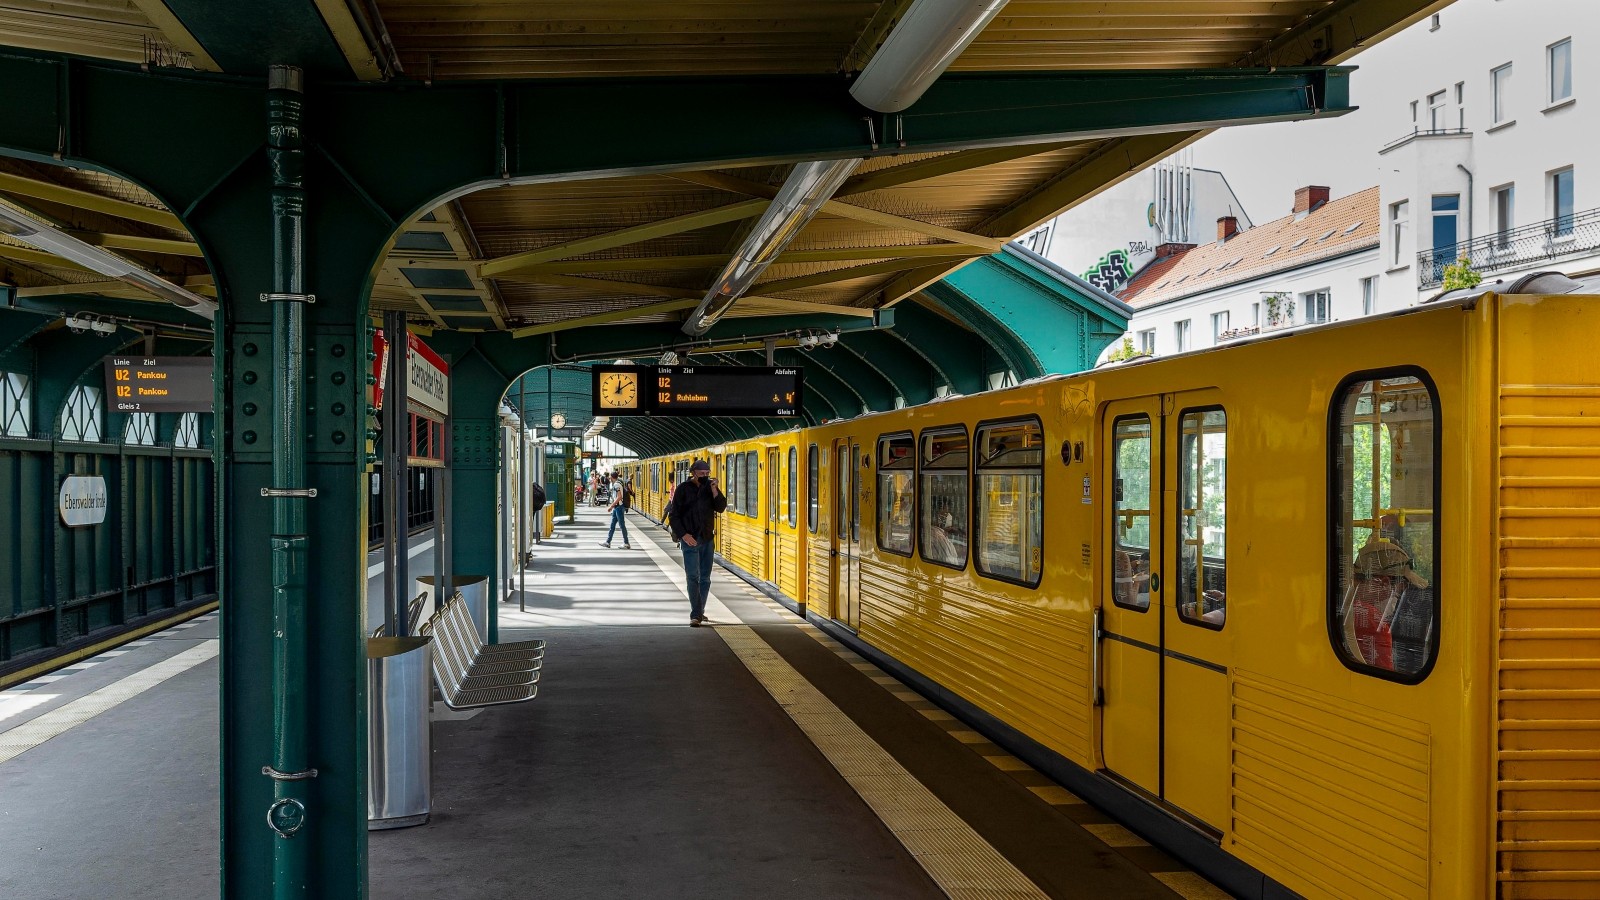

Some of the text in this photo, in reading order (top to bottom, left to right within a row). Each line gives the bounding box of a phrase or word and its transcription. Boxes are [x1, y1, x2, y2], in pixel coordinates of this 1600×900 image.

[115, 369, 167, 381] U2 Pankow
[658, 377, 671, 388] U2
[116, 385, 168, 397] U2 Pankow
[658, 392, 671, 403] U2
[676, 394, 708, 402] Ruhleben
